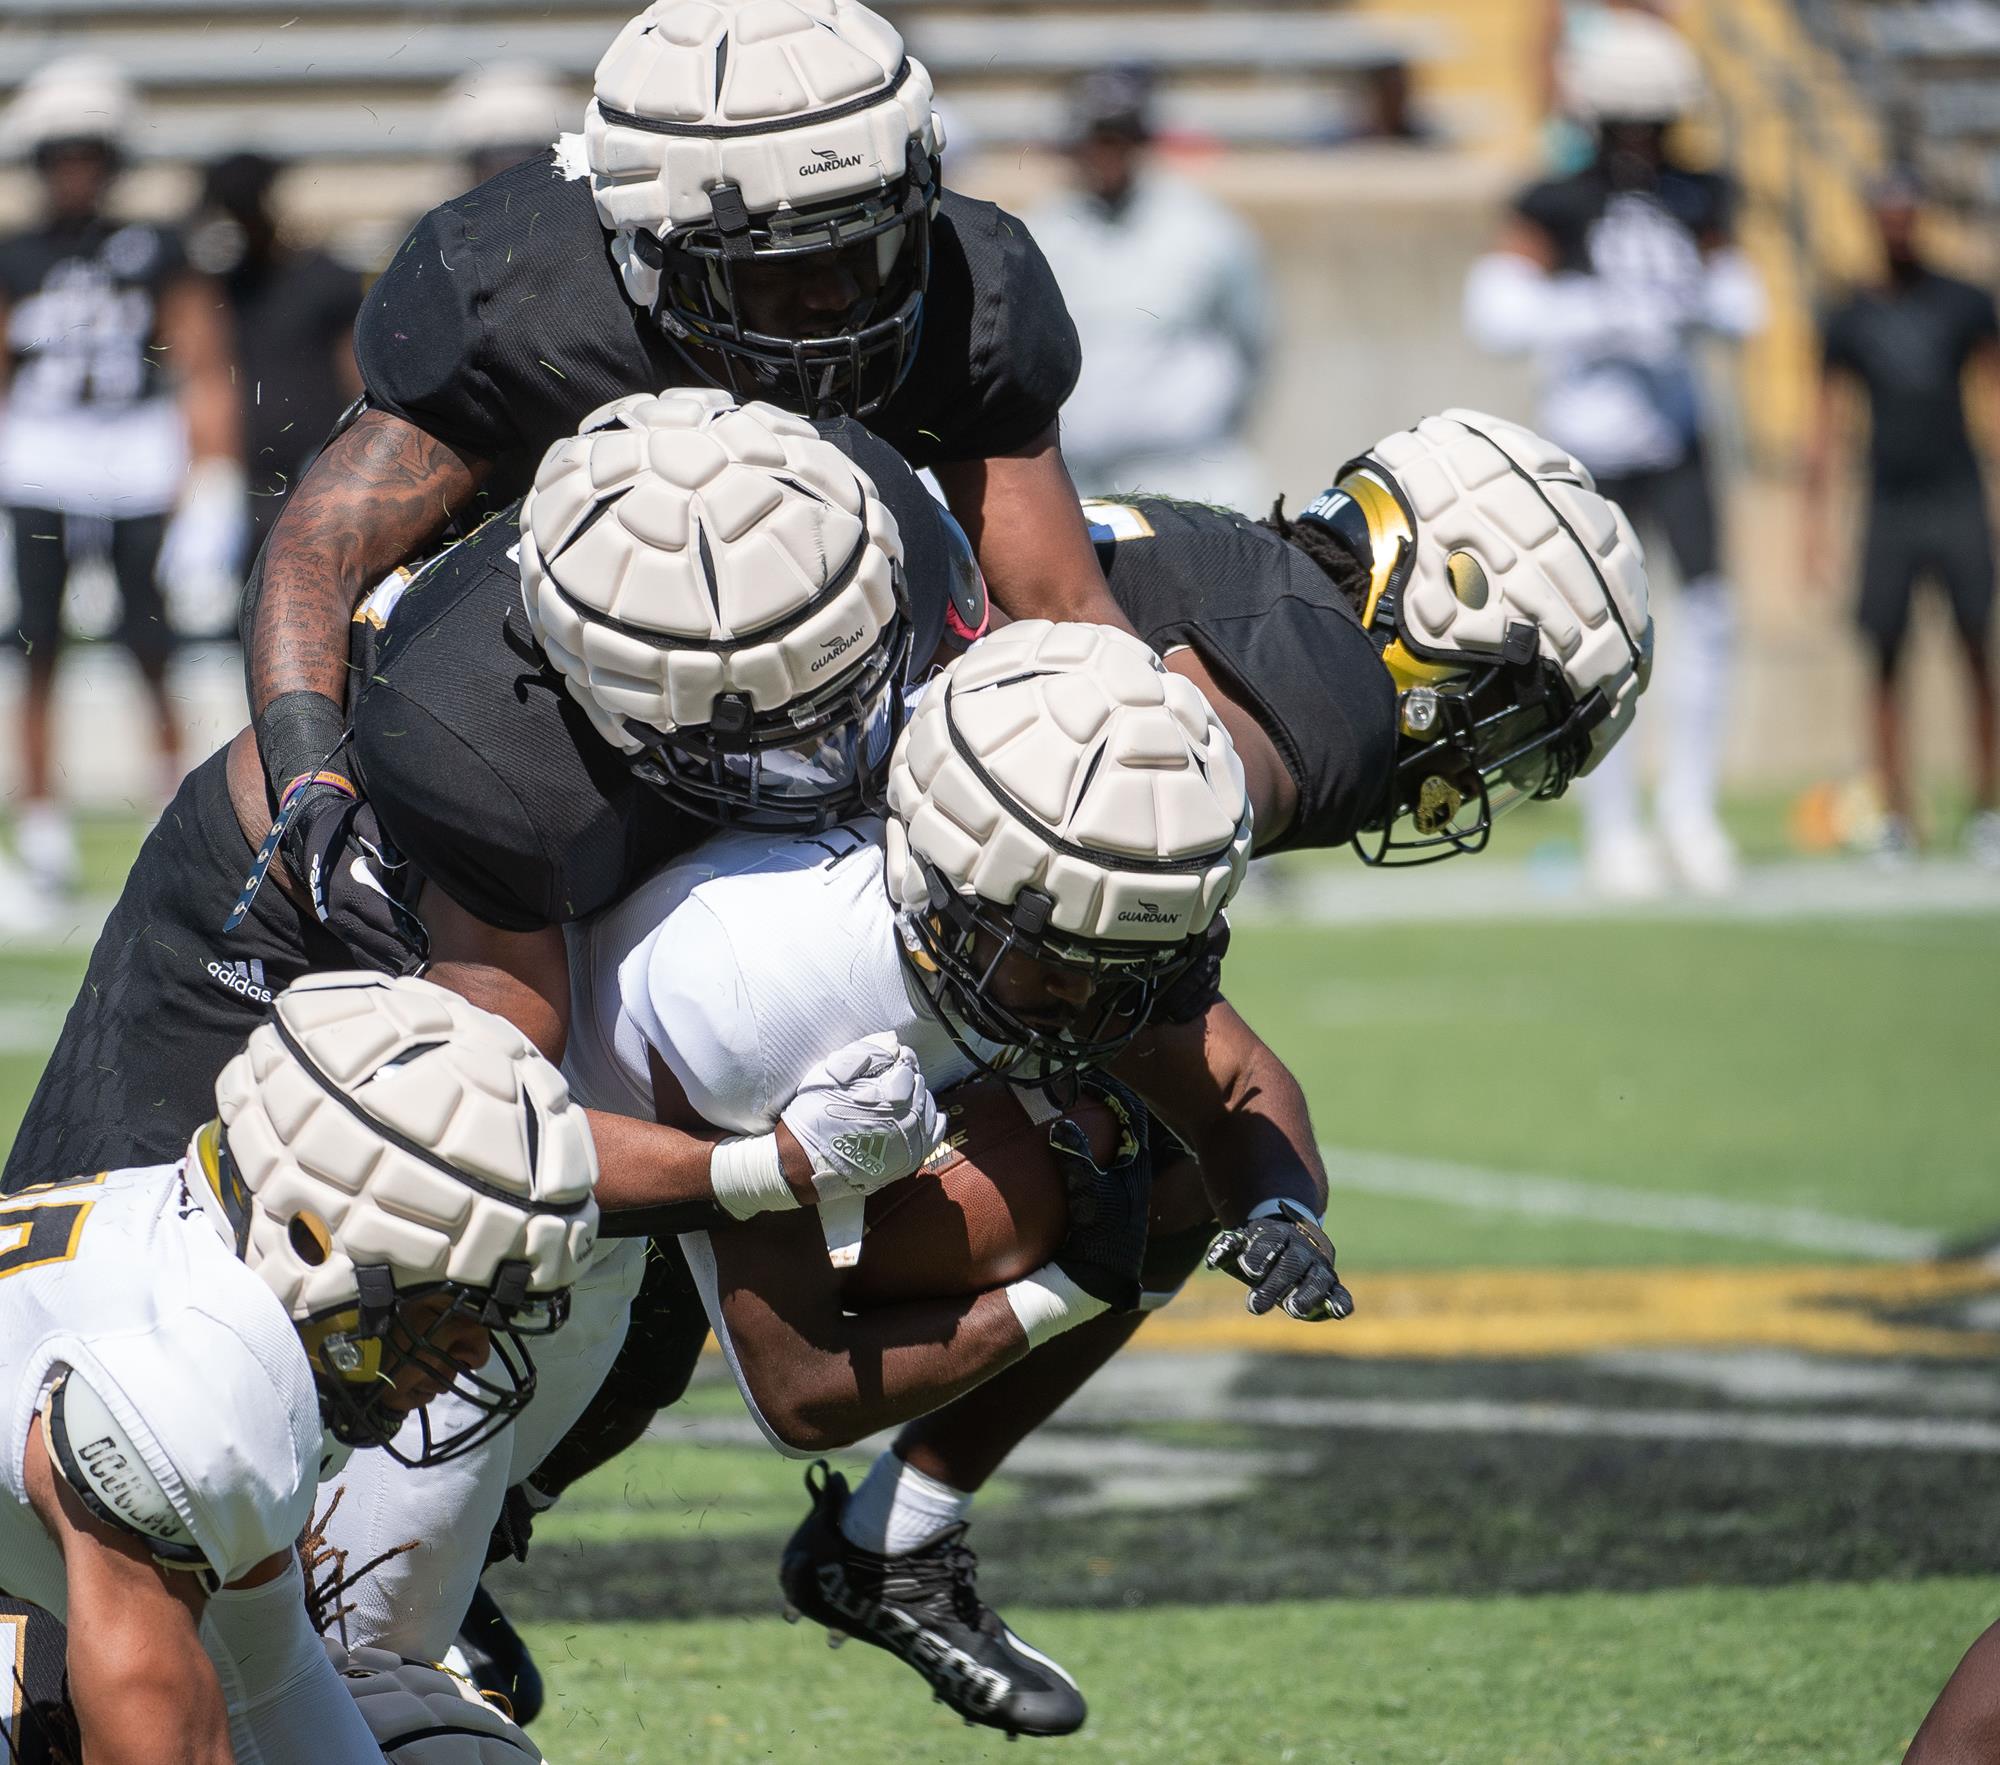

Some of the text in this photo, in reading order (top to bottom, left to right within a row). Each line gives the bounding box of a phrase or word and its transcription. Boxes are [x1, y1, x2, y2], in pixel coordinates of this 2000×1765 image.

[799, 154, 861, 176] GUARDIAN
[811, 628, 864, 672] GUARDIAN
[1118, 911, 1179, 923] GUARDIAN
[207, 962, 272, 1002] adidas
[832, 1138, 884, 1175] adidas
